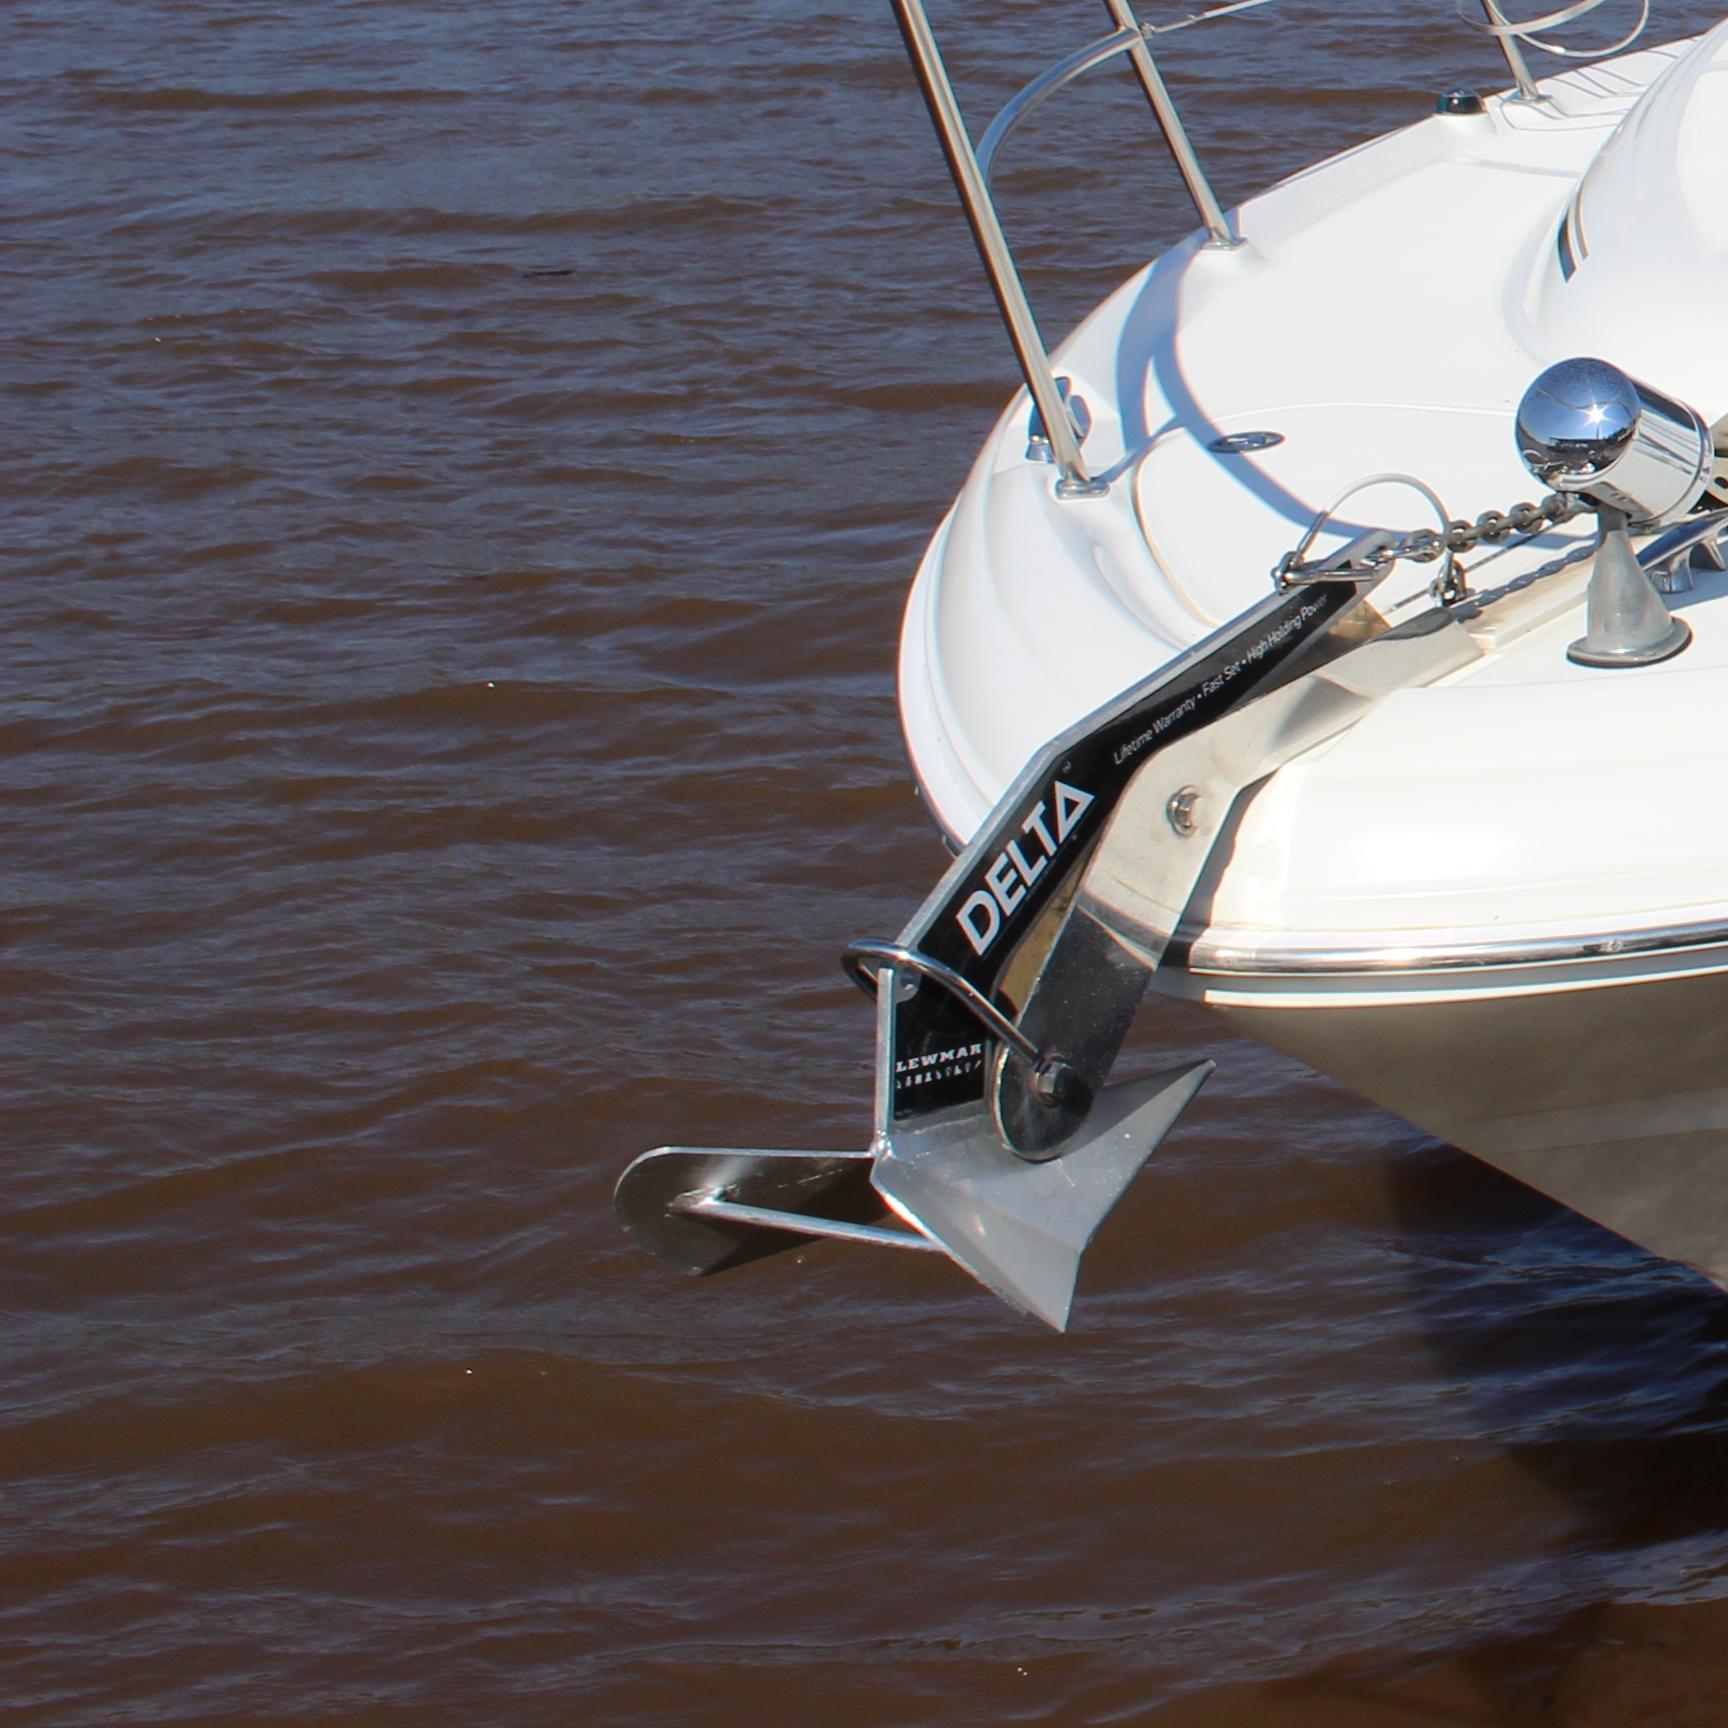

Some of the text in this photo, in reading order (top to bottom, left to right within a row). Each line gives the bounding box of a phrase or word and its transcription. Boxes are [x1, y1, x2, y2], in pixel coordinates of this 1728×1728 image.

[1112, 593, 1328, 764] Lifetime Warranty Fast Set High Holding Power
[956, 780, 1096, 956] DELTA
[896, 1043, 982, 1072] LEWMAR
